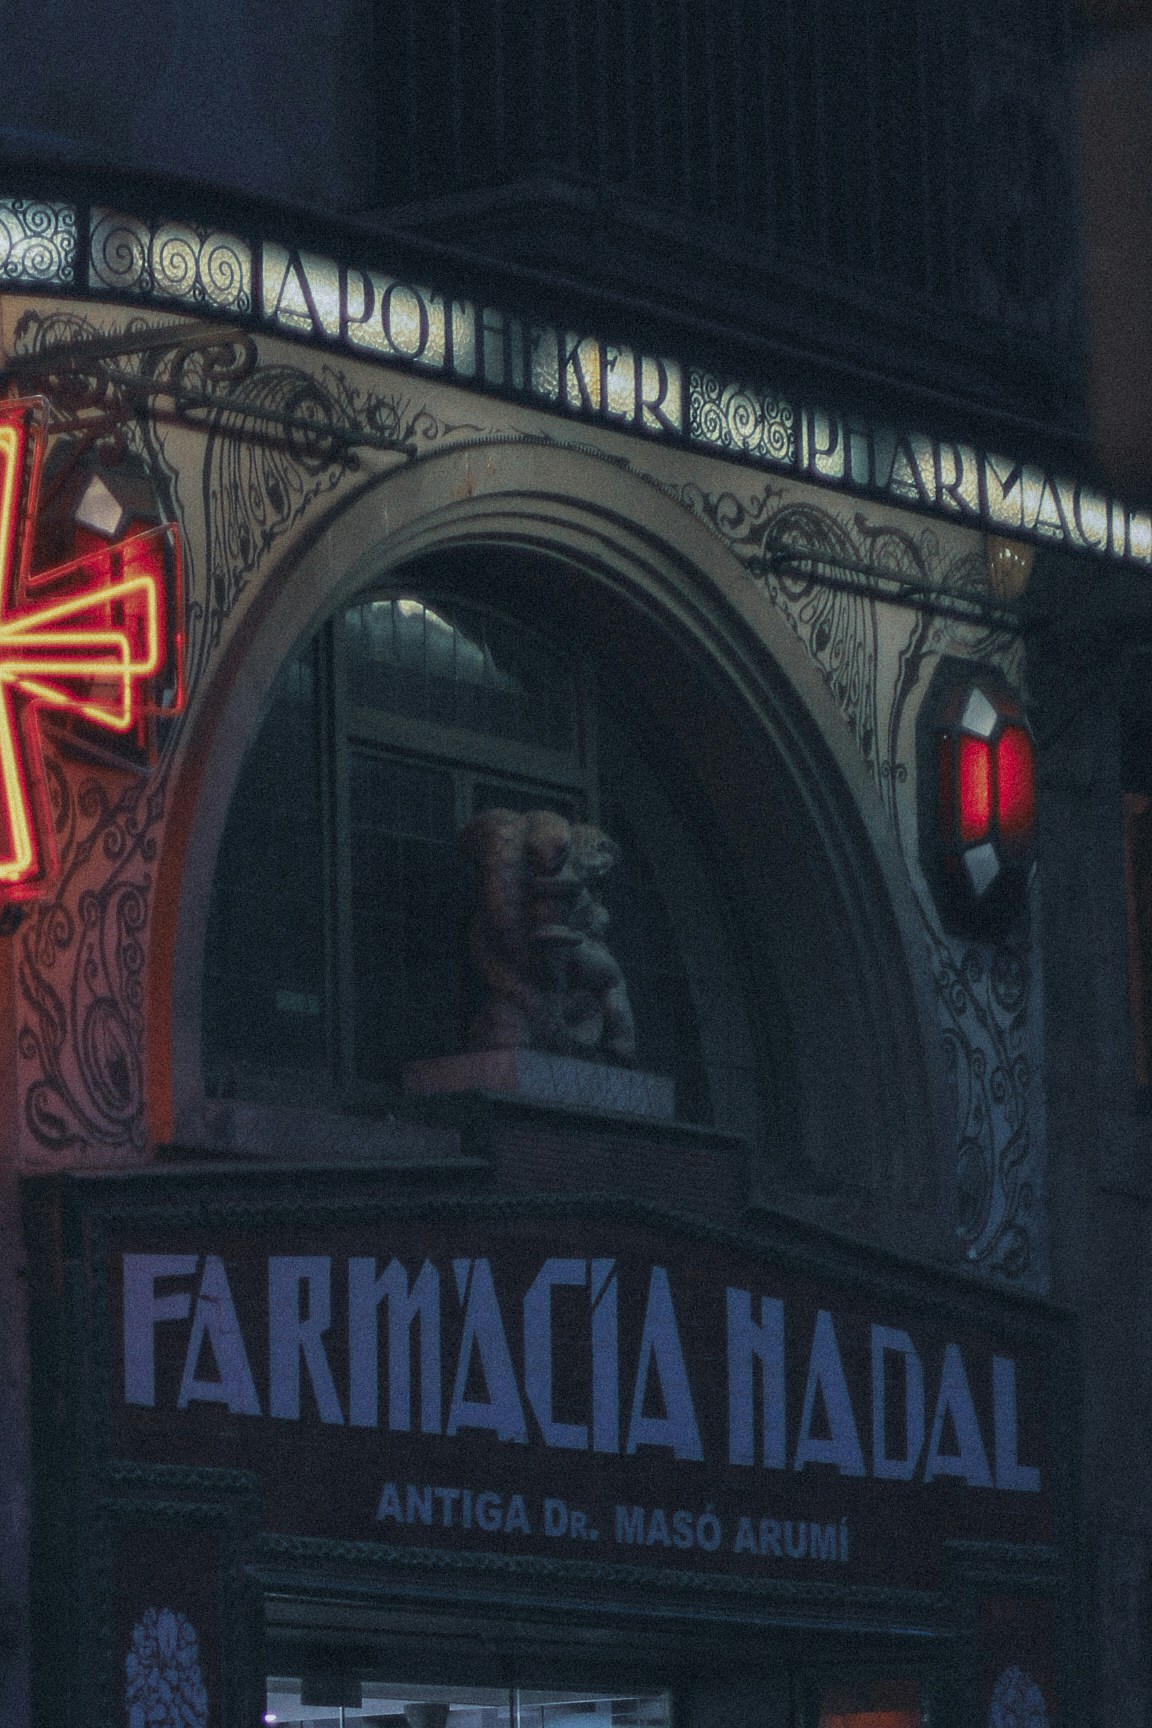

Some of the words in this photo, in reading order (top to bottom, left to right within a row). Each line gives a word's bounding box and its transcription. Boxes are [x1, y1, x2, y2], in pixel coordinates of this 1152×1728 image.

[270, 246, 686, 434] APOTHEKER
[725, 1285, 1042, 1493] NADAL
[375, 1482, 530, 1534] ANTIGA
[616, 1503, 723, 1551] MASÓ
[734, 1517, 849, 1562] ARUMÍ
